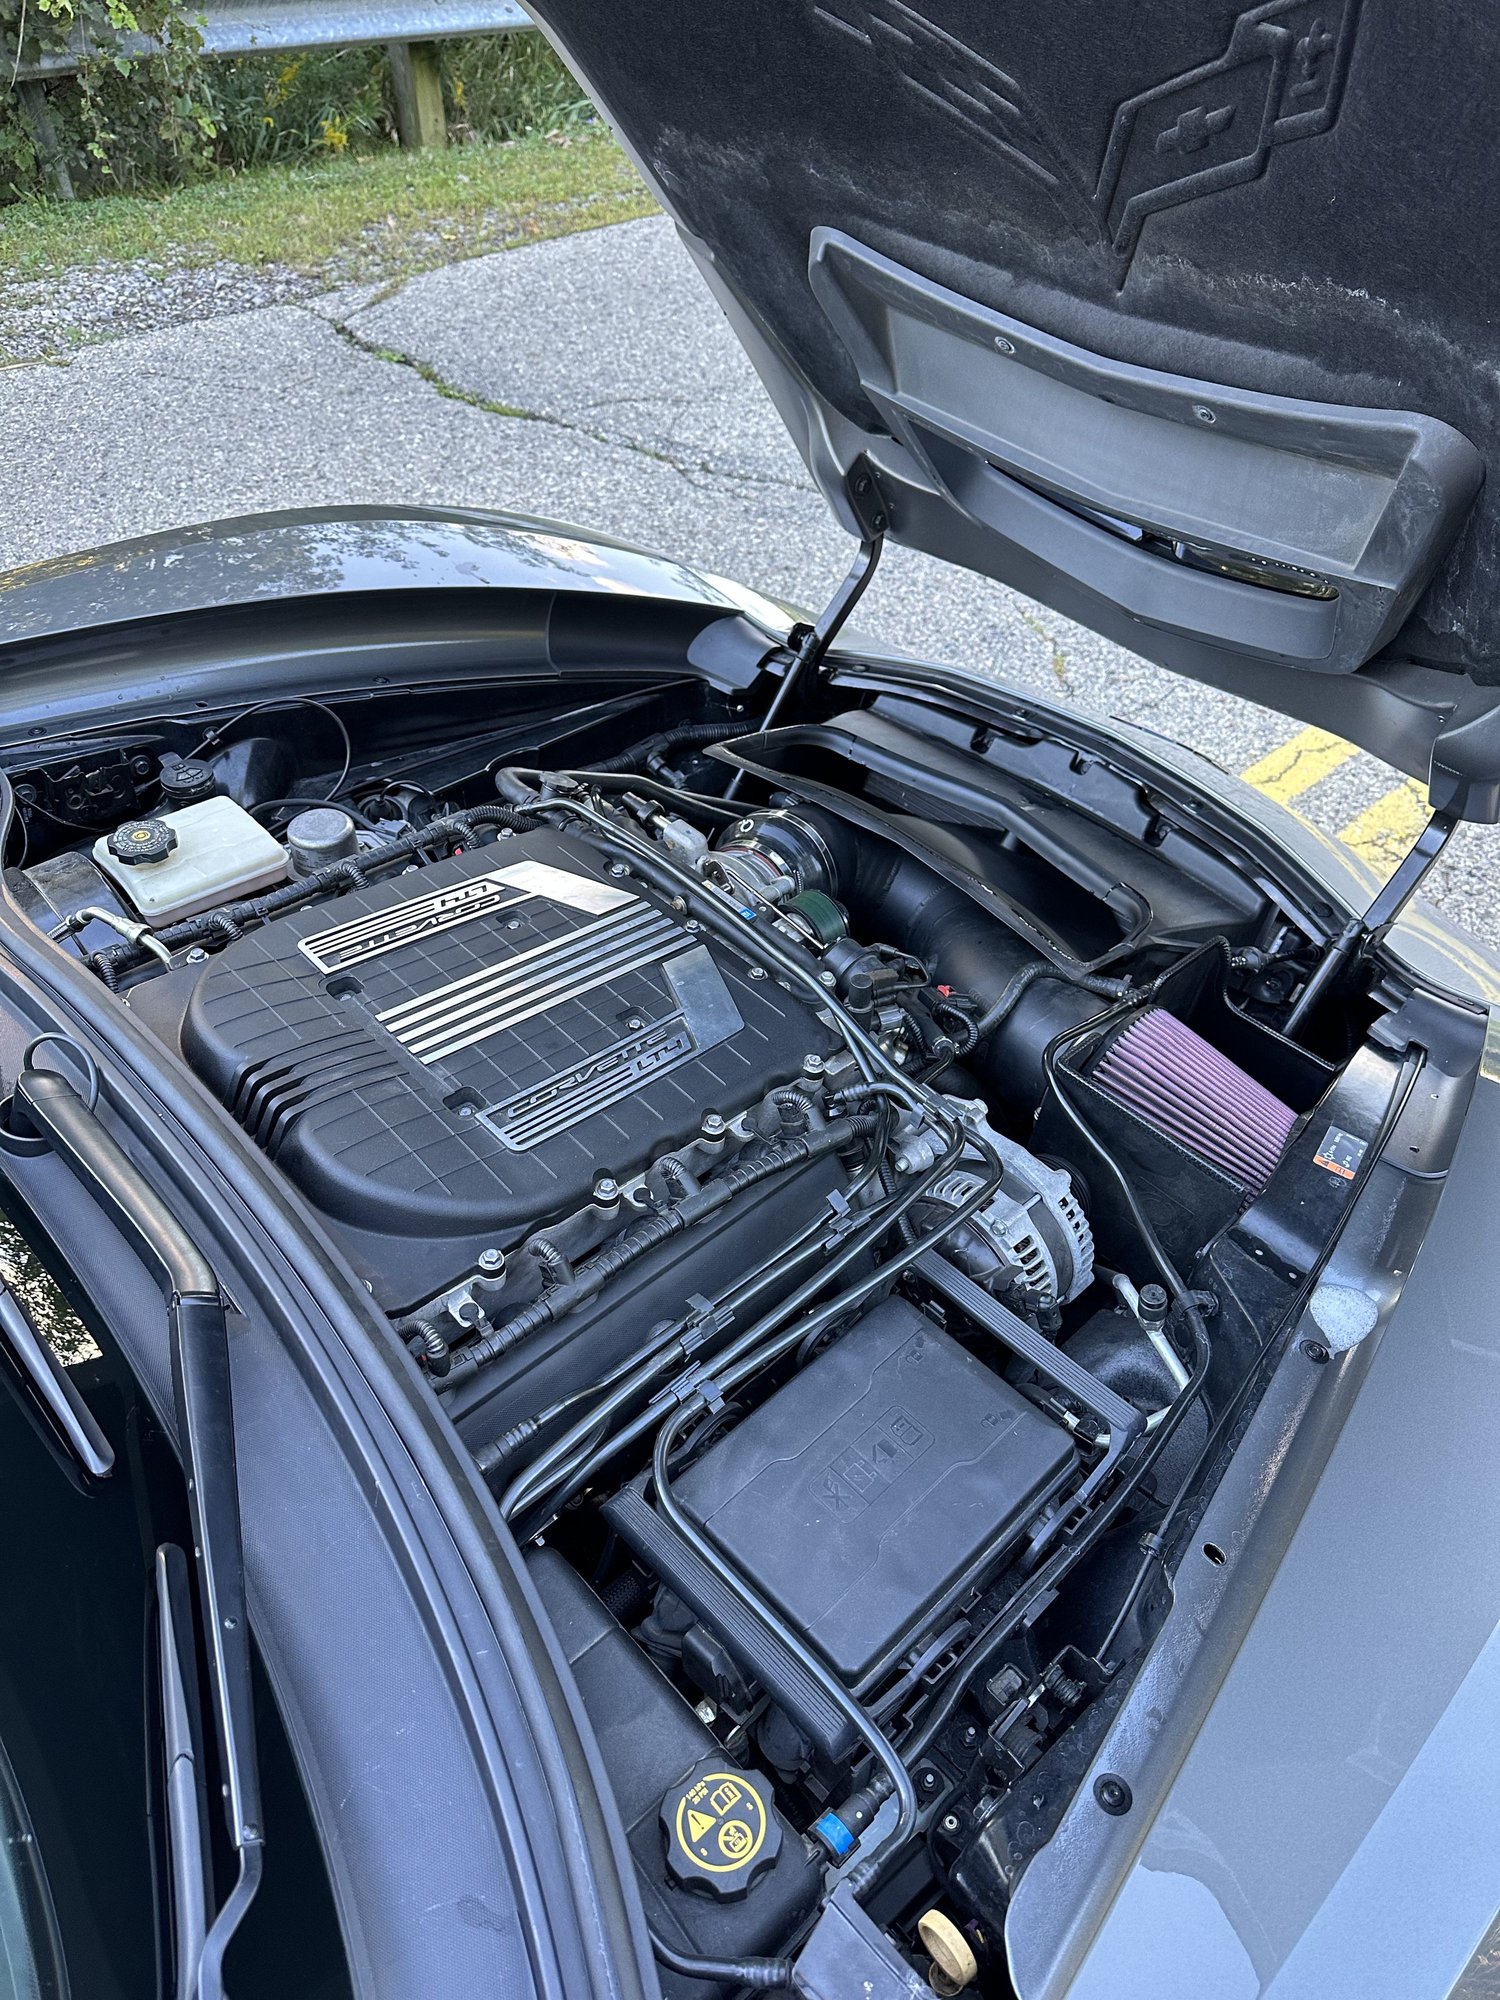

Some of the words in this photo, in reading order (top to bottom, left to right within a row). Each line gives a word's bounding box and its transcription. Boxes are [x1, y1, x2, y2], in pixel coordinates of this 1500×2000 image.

[440, 884, 488, 907] LT4
[339, 894, 501, 960] CORVETTE
[507, 1028, 668, 1118] CORVETTE
[635, 1037, 685, 1071] LT4
